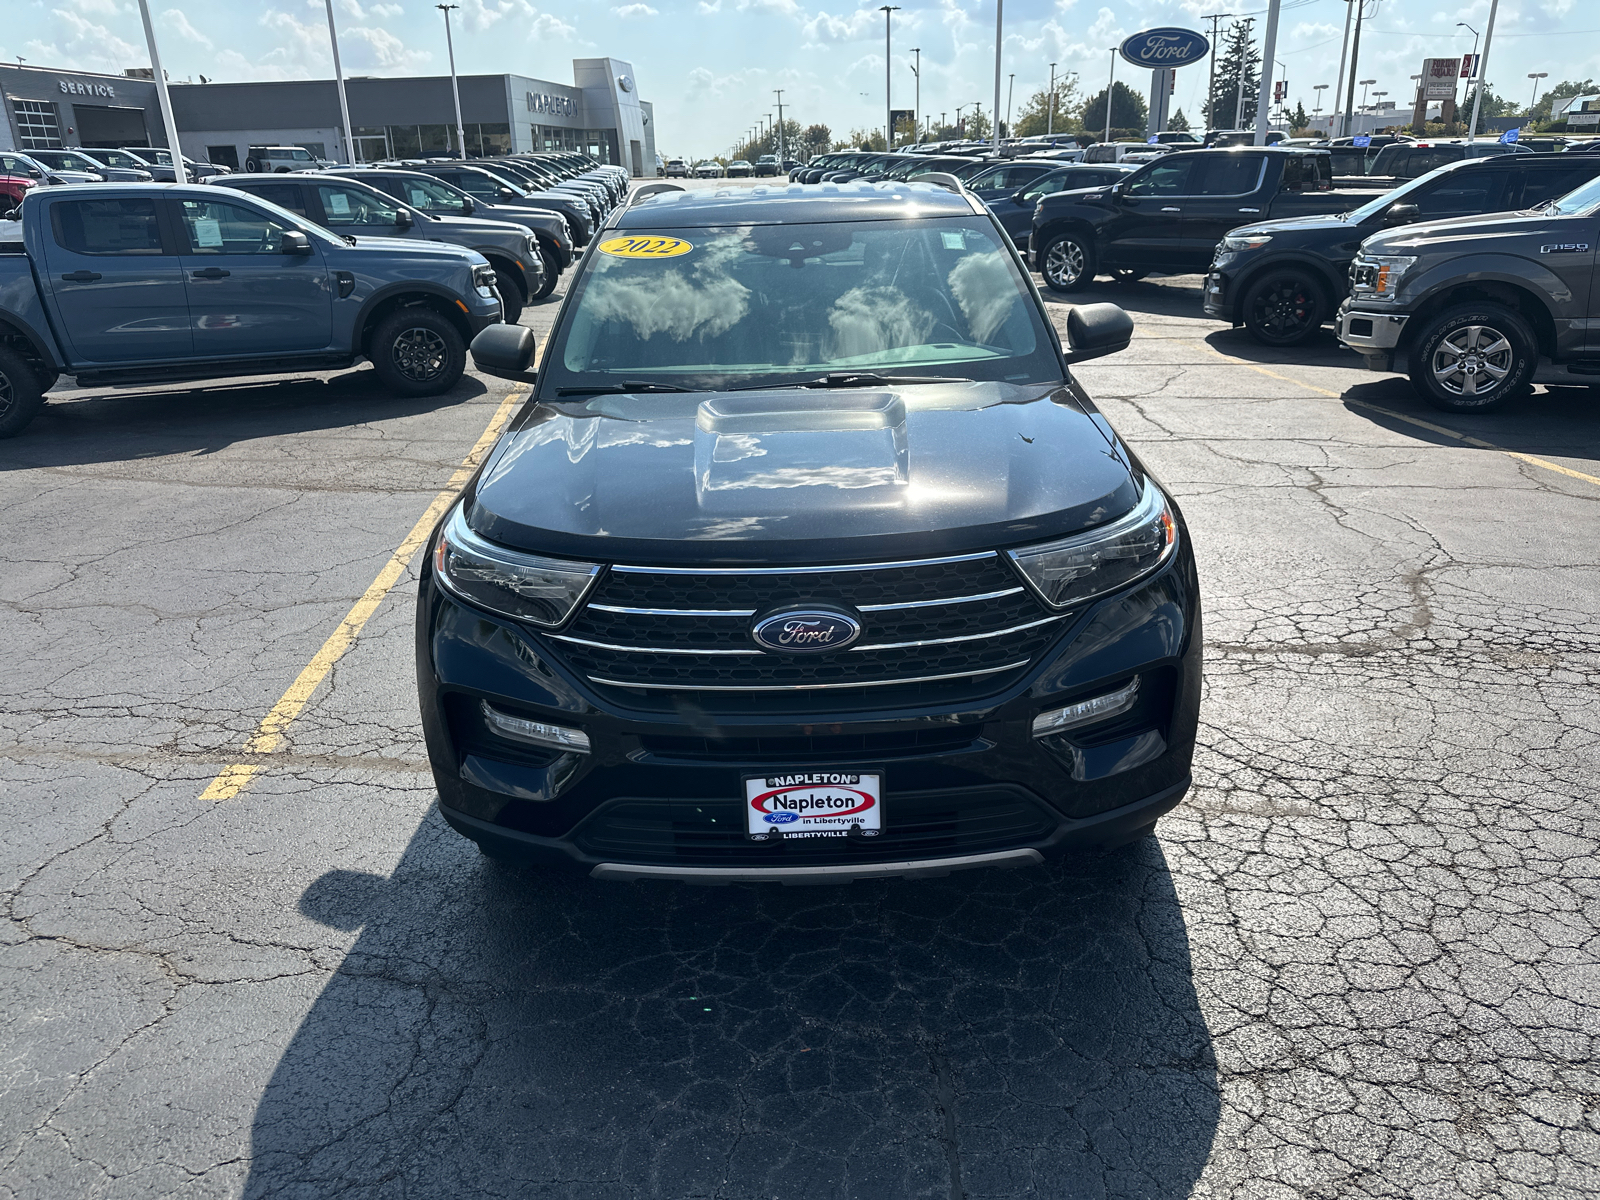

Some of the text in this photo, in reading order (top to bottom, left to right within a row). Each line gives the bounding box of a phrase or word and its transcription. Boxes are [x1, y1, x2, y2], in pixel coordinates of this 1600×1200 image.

[1140, 35, 1193, 59] Ford
[59, 80, 115, 98] SERVICE
[526, 91, 579, 118] NAPLETON
[612, 239, 681, 254] 2022
[778, 620, 835, 644] Ford
[774, 773, 851, 787] NAPLETON
[773, 794, 855, 813] Napleton
[770, 813, 793, 822] Ford
[814, 816, 865, 825] Libertyville
[783, 831, 848, 839] LIBERTYVILLE
